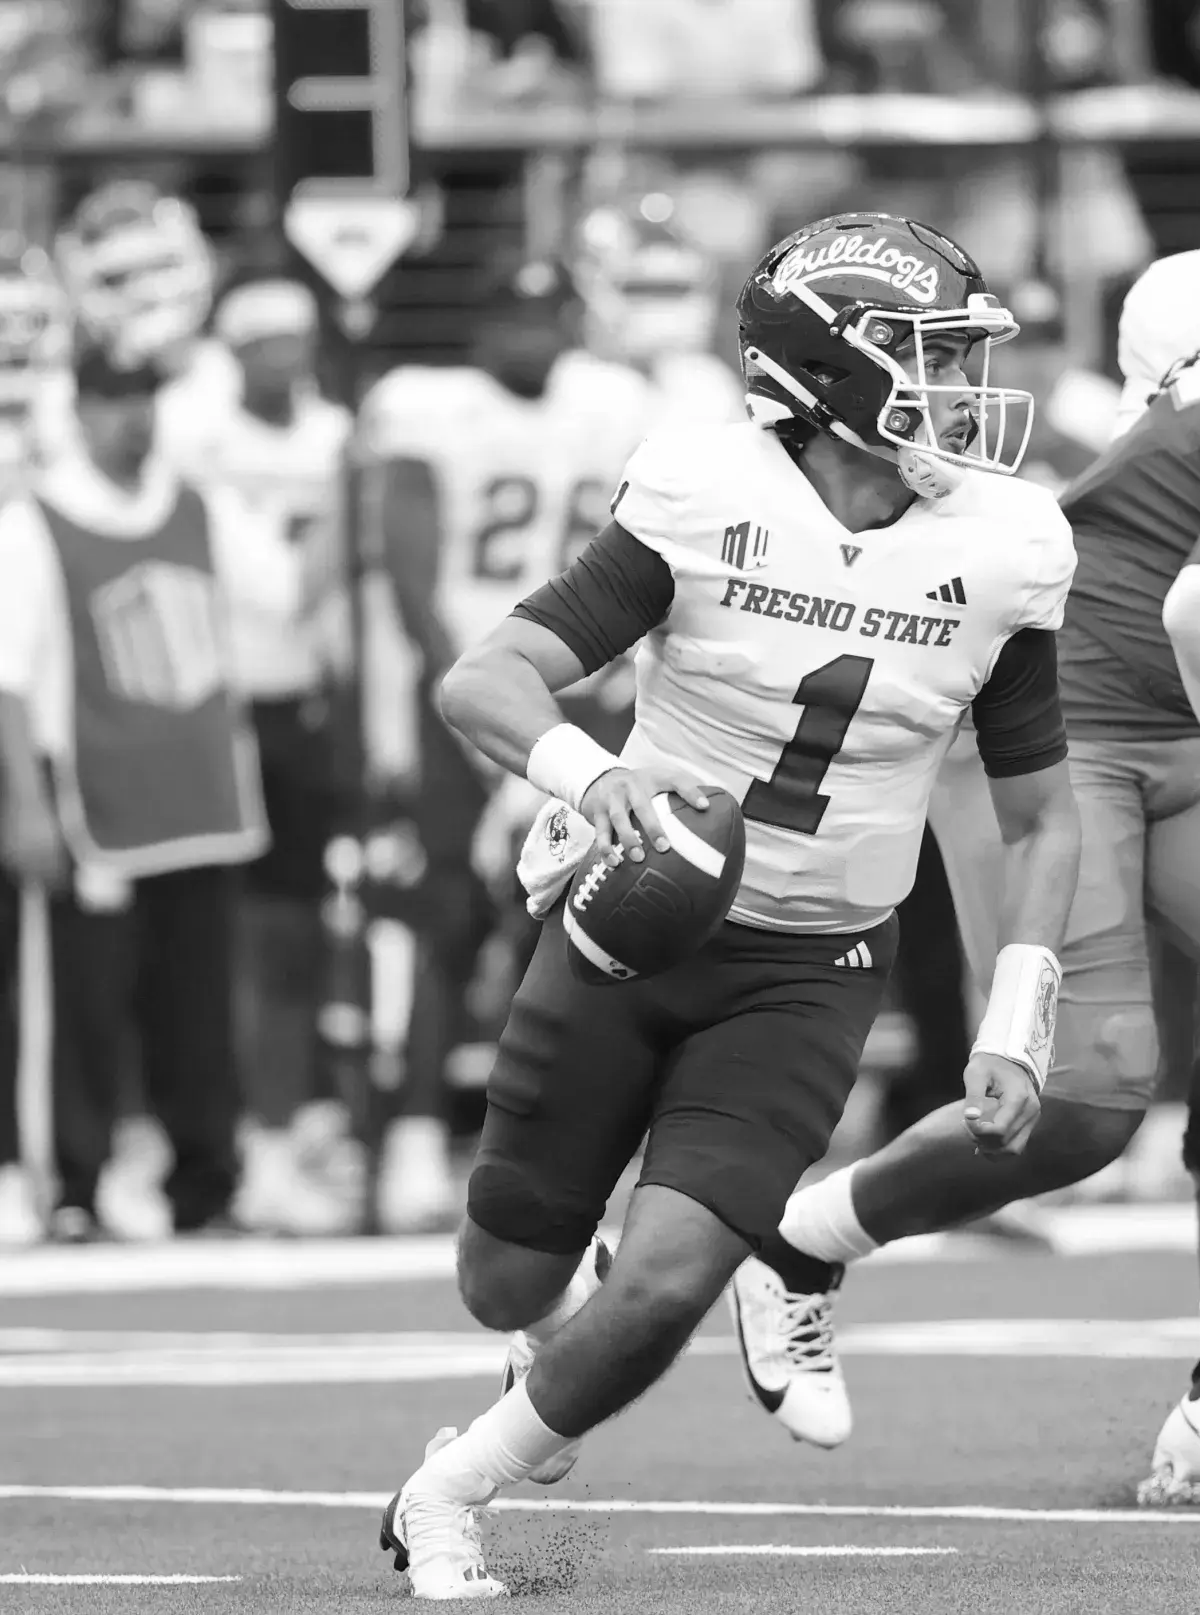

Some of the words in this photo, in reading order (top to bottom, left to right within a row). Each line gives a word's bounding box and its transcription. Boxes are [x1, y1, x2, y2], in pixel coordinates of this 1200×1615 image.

[772, 235, 939, 304] Bulldogs
[839, 543, 863, 568] V
[719, 578, 856, 632] FRESNO
[859, 607, 960, 647] STATE
[740, 653, 875, 836] 1
